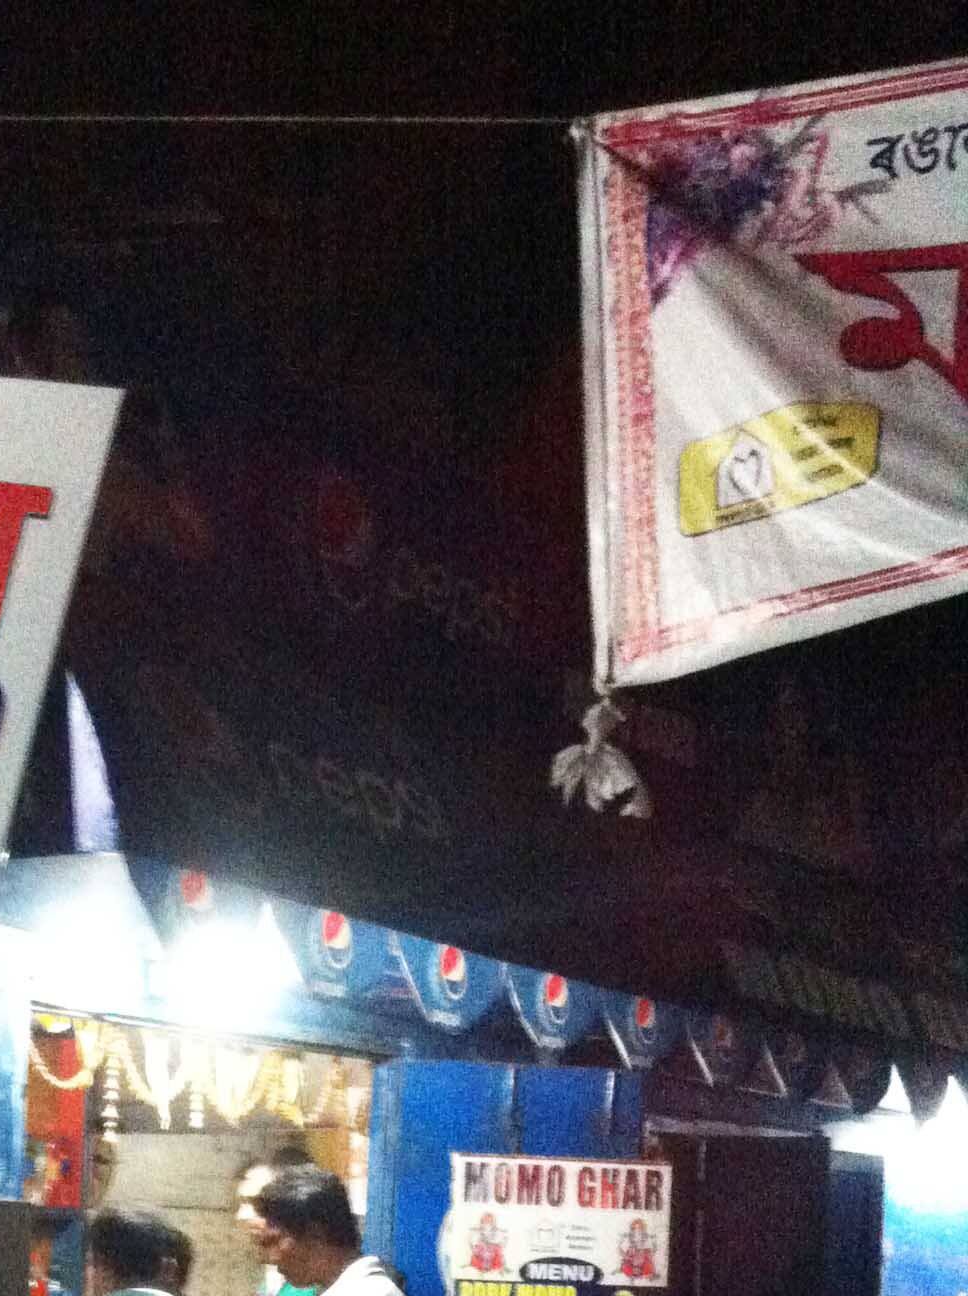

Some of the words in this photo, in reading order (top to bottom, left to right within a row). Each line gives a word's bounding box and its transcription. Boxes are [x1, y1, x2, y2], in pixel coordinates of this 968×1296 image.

[866, 123, 968, 180] ৰঙা
[463, 1161, 567, 1207] MOMO
[577, 1165, 664, 1211] GHAR
[527, 1262, 596, 1283] MENU
